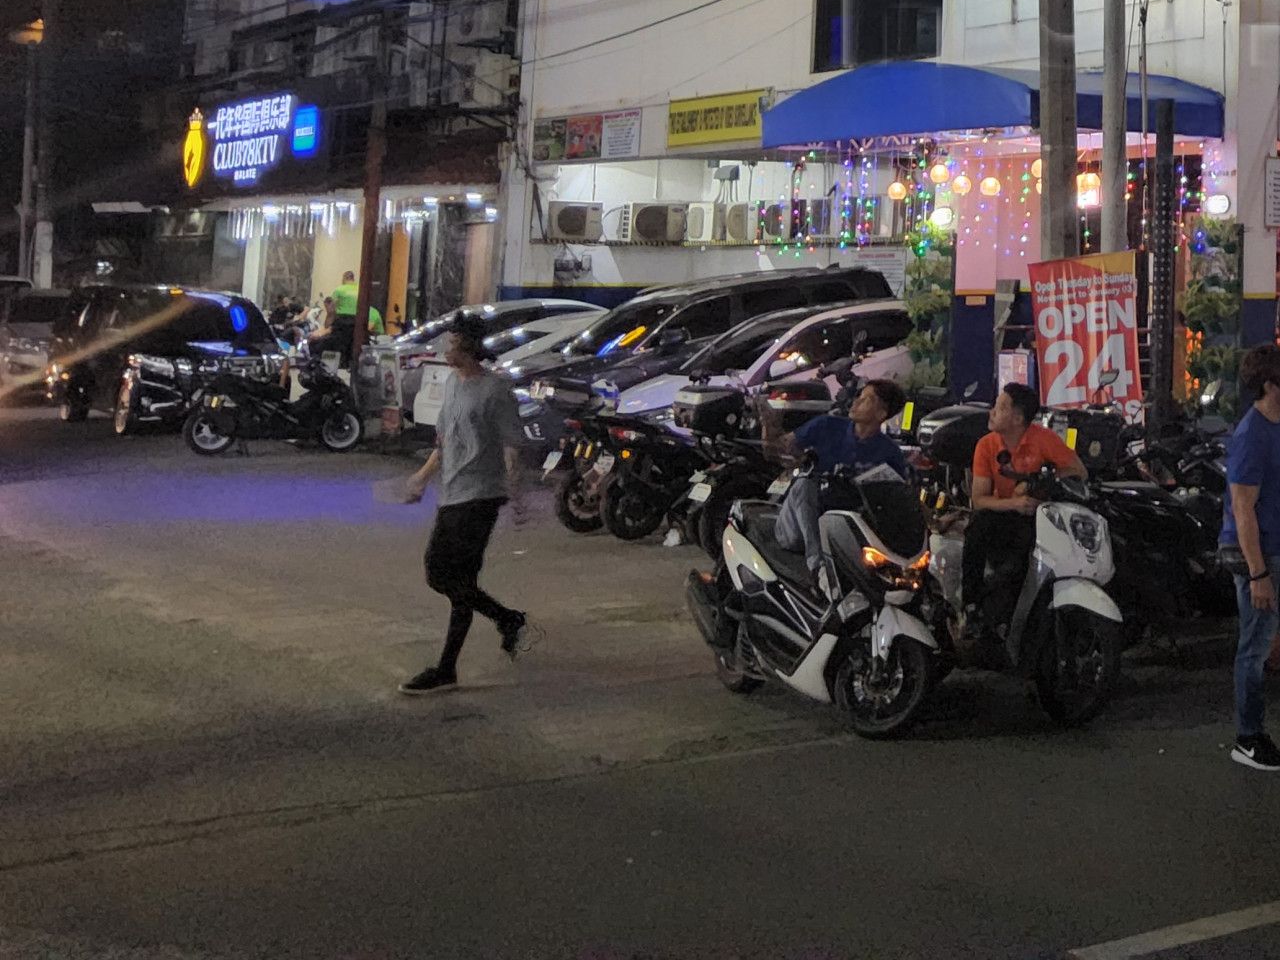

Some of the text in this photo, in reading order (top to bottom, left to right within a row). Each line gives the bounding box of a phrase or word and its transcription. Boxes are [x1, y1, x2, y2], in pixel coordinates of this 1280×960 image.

[213, 134, 279, 171] CLUB78KTV
[1078, 290, 1087, 298] to
[1037, 297, 1135, 339] OPEN
[1044, 333, 1134, 407] 24
